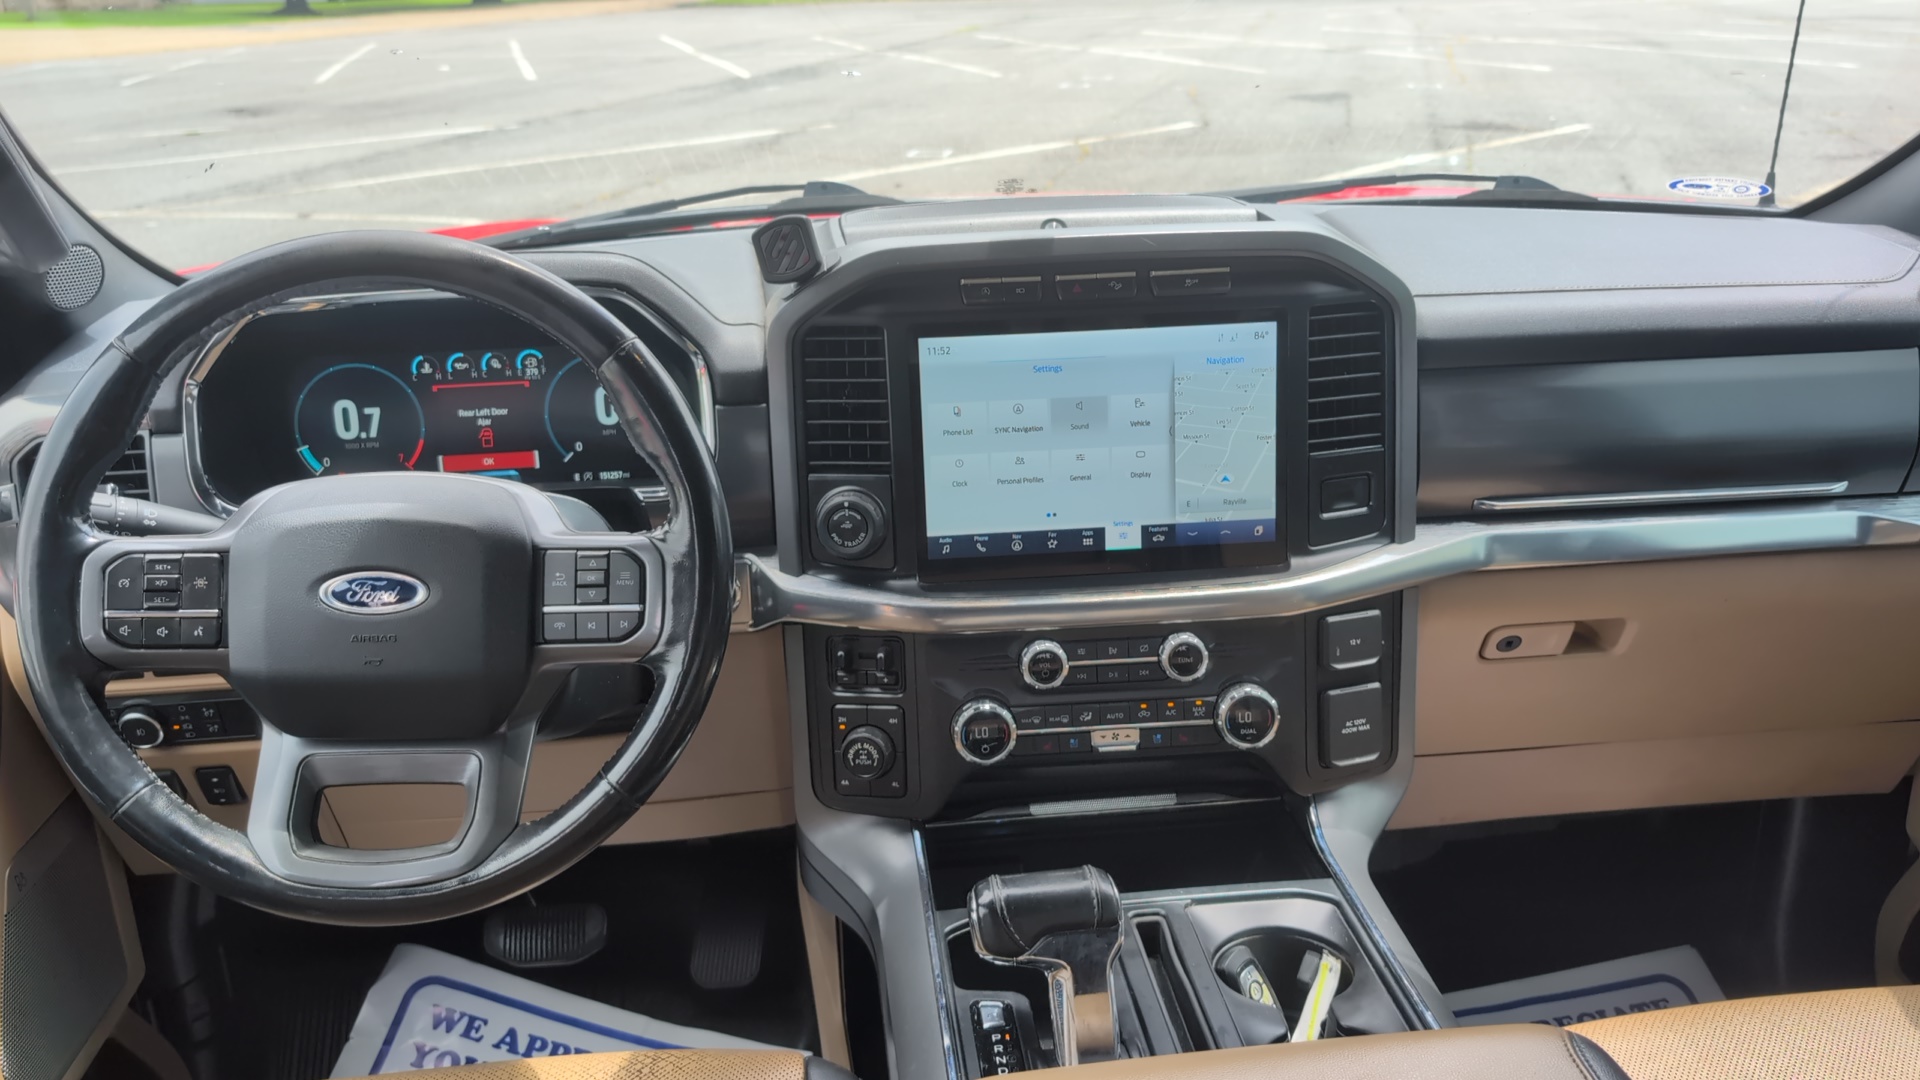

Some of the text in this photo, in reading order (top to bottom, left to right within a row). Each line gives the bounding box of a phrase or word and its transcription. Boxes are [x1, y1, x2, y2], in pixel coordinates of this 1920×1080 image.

[927, 346, 951, 356] 11:52
[1206, 355, 1245, 366] Navigation
[1033, 363, 1063, 374] Settings
[458, 407, 508, 417] Rear Left Door
[333, 399, 381, 440] 0.7
[477, 419, 492, 427] Ajar
[1130, 419, 1151, 428] Vehicle
[995, 425, 1044, 435] SYNC Navigation
[1070, 422, 1089, 430] Sound
[943, 429, 962, 437] Phone
[366, 441, 380, 449] RPM
[575, 441, 583, 452] 0
[323, 457, 331, 467] 0
[398, 453, 404, 463] 7
[483, 458, 494, 466] OK
[1070, 473, 1092, 482] General
[1130, 471, 1151, 479] Display
[952, 480, 968, 488] Clock
[997, 476, 1044, 486] Personal Profiles
[1223, 498, 1247, 506] Rayville
[1113, 520, 1134, 528] Settings
[1081, 529, 1094, 537] Apps
[831, 532, 866, 547] PRO TRAILER
[973, 534, 989, 542] Phone
[346, 579, 401, 603] Ford
[350, 634, 398, 643] AIRBAG
[1106, 712, 1124, 720] AUTO
[1354, 718, 1367, 726] 120V
[1358, 724, 1371, 732] MAX
[847, 742, 879, 759] DRIVE MODE
[432, 1003, 489, 1043] WE
[992, 1034, 1009, 1076] P R N D
